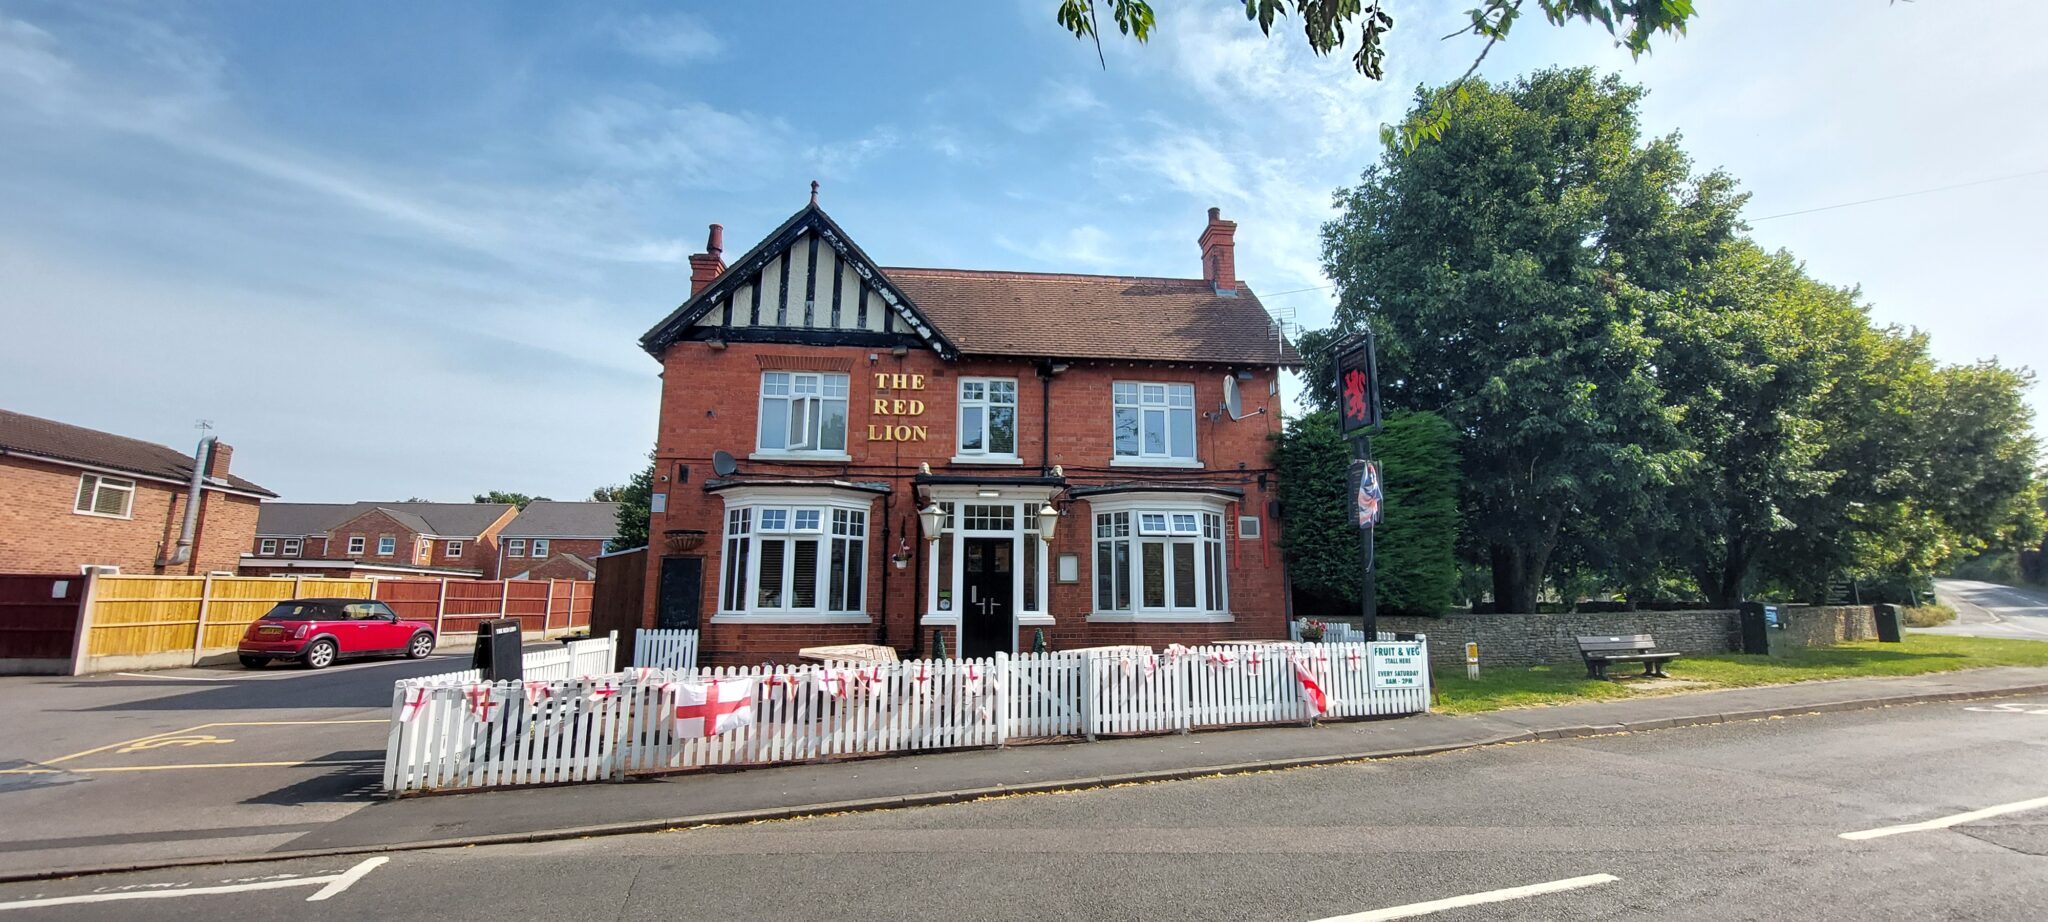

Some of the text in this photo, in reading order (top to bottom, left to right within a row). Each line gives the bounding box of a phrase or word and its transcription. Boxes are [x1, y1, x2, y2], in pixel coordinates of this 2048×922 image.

[875, 373, 925, 390] THE
[874, 399, 925, 415] RED
[867, 425, 928, 442] LION
[1374, 646, 1420, 656] FRUIT & VEG
